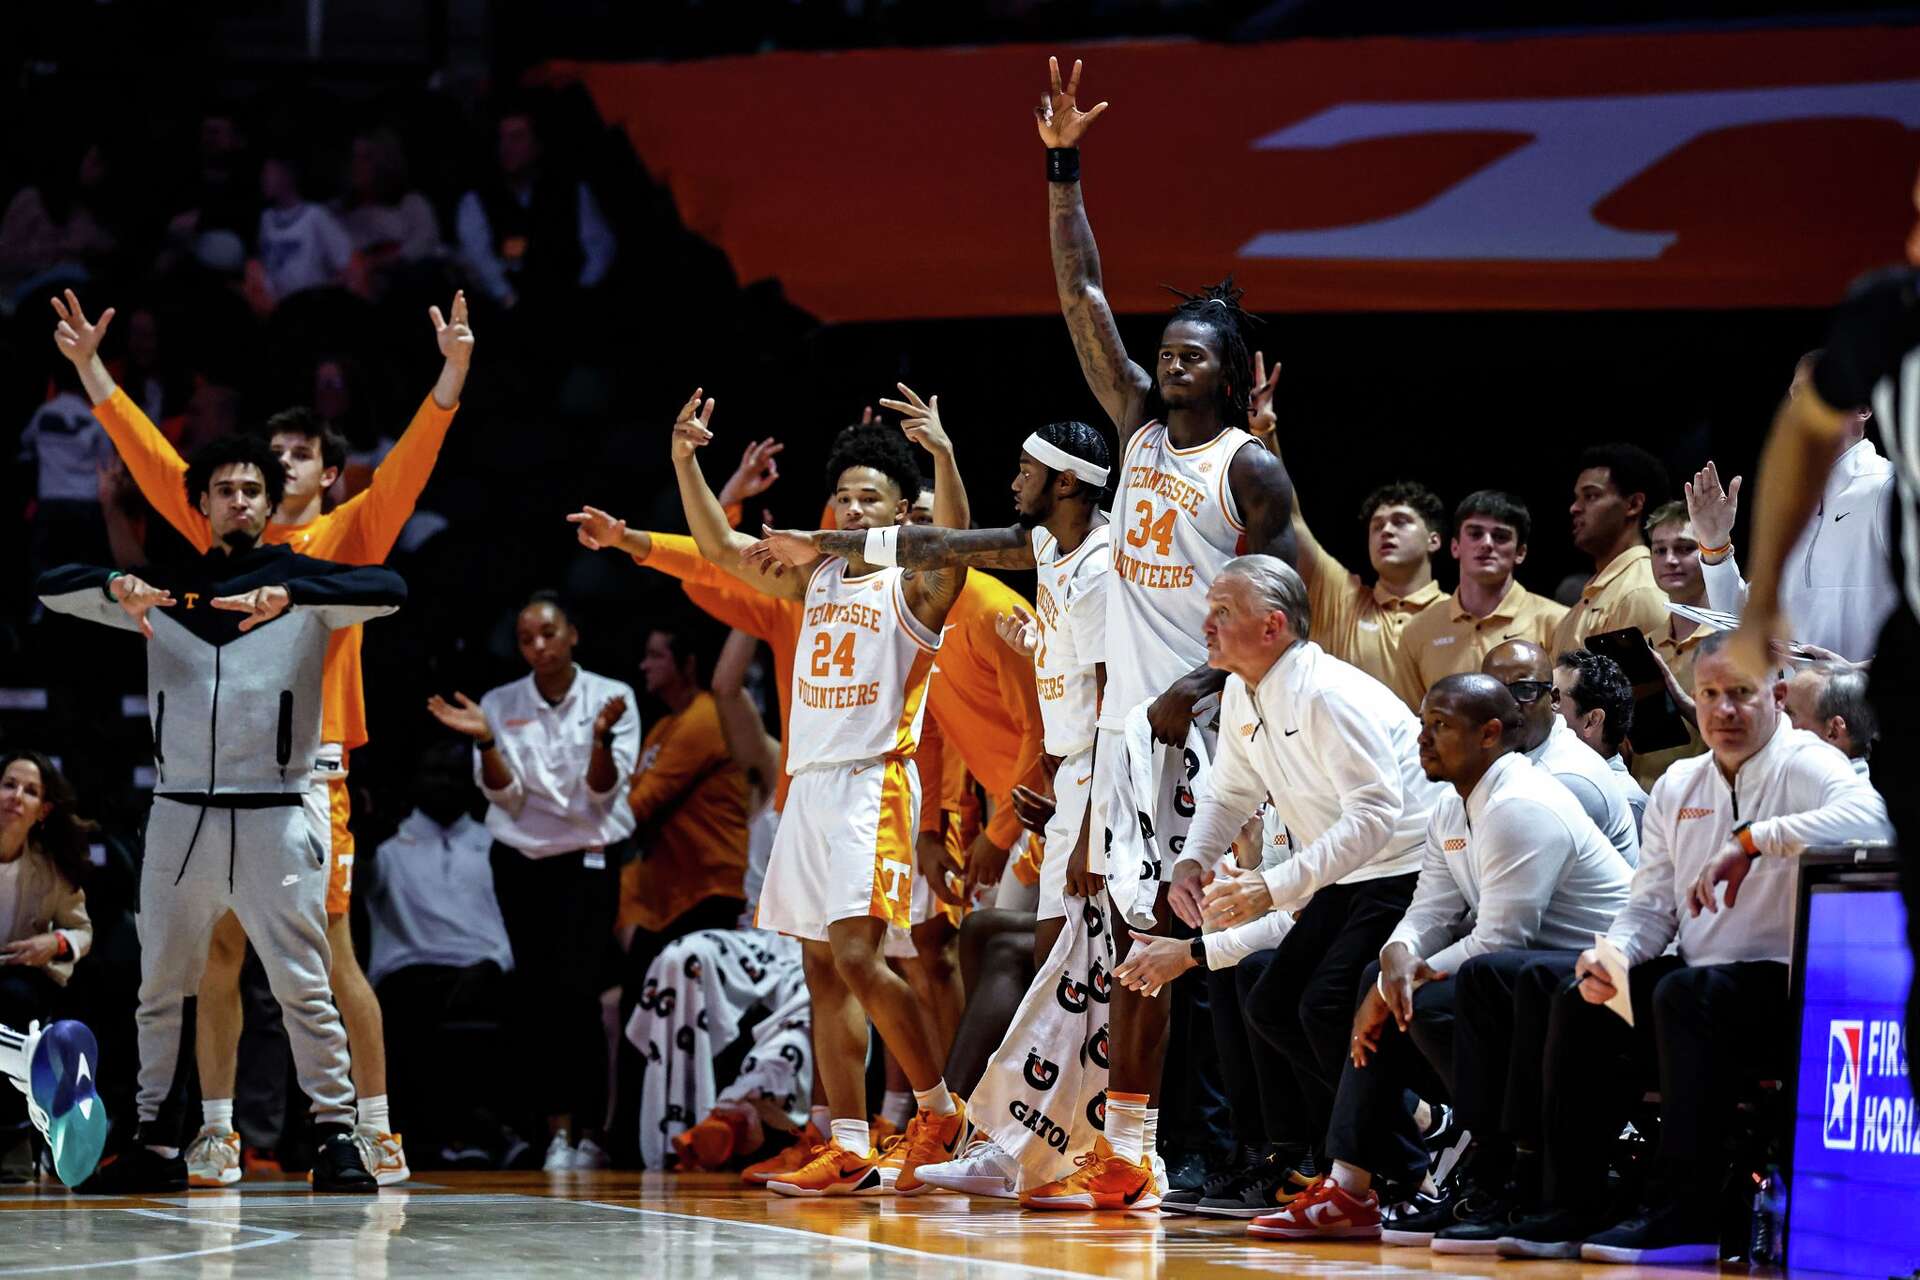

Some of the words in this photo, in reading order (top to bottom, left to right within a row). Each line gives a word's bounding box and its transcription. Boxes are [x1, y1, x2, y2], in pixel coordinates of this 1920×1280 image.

[1127, 499, 1178, 556] 34
[185, 592, 199, 609] T
[811, 632, 856, 677] 24
[798, 676, 880, 709] VOLUNTEERS
[883, 857, 912, 902] T
[1023, 1051, 1060, 1091] G
